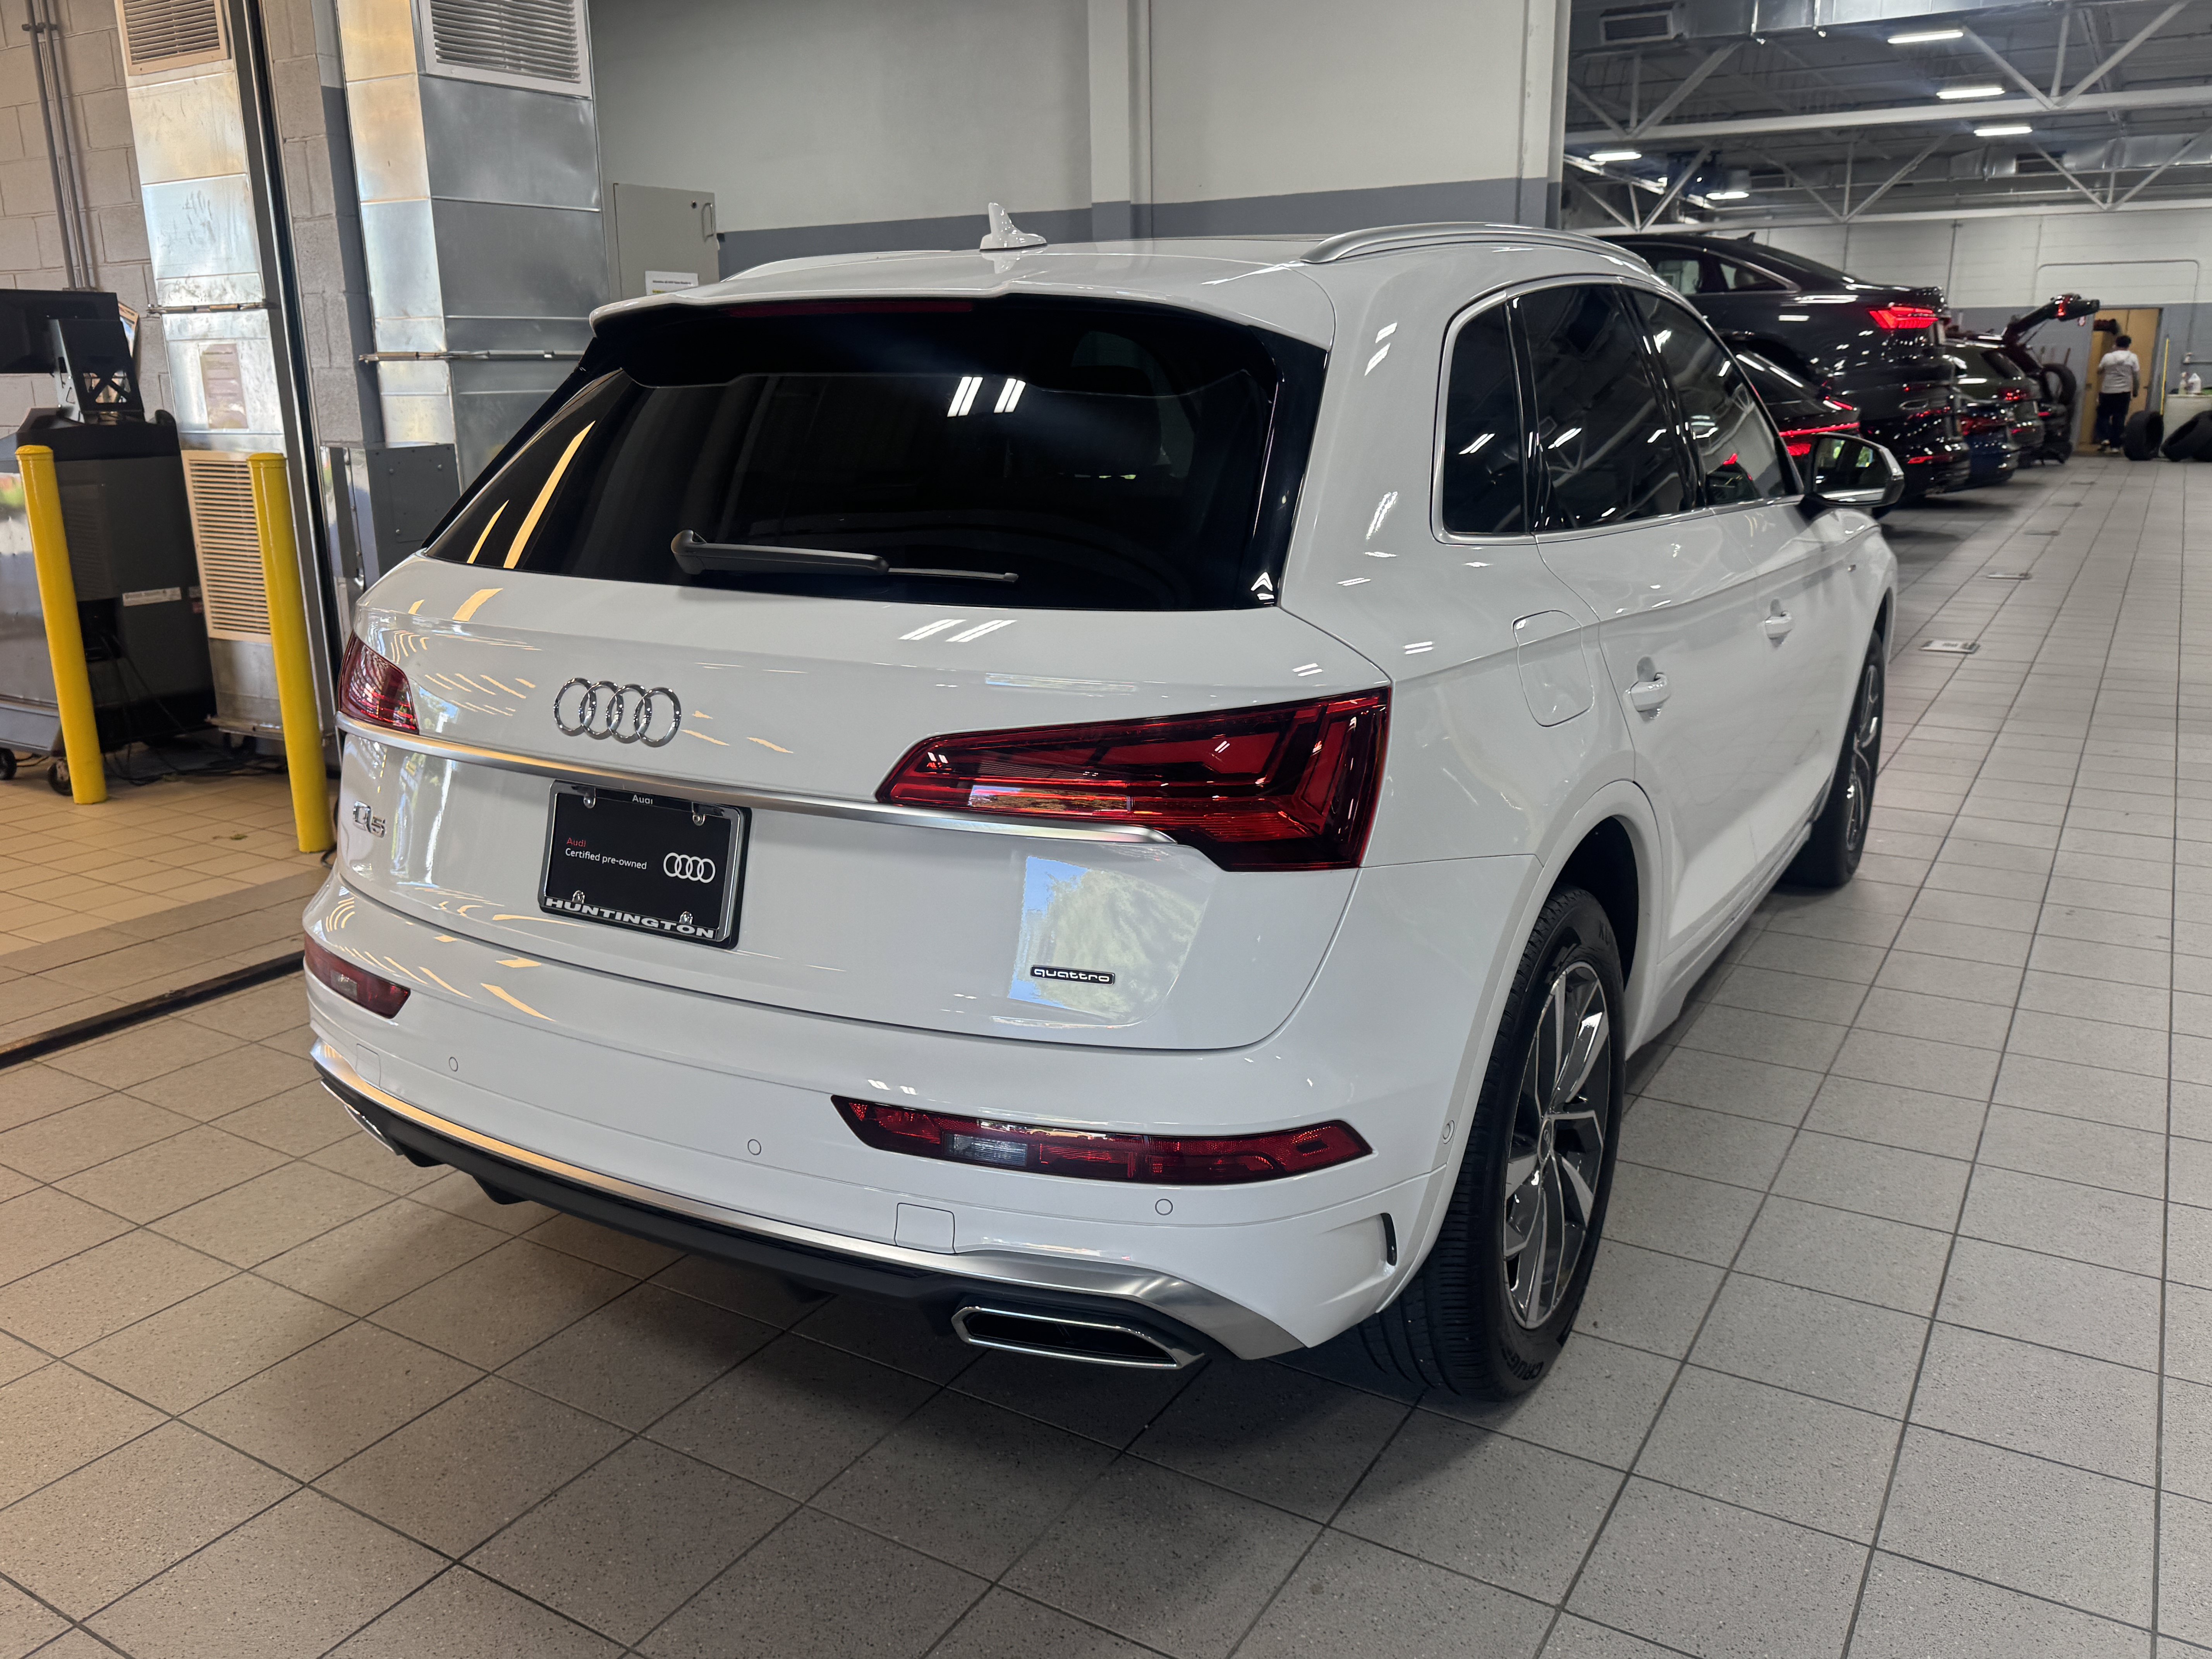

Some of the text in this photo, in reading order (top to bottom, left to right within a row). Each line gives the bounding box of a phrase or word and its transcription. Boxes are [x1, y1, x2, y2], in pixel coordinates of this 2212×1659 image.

[353, 800, 386, 838] Q5
[566, 837, 586, 847] Audi
[565, 848, 647, 870] Certified pre-owned
[545, 898, 714, 939] HUNTINGTON
[1034, 969, 1110, 982] quattro
